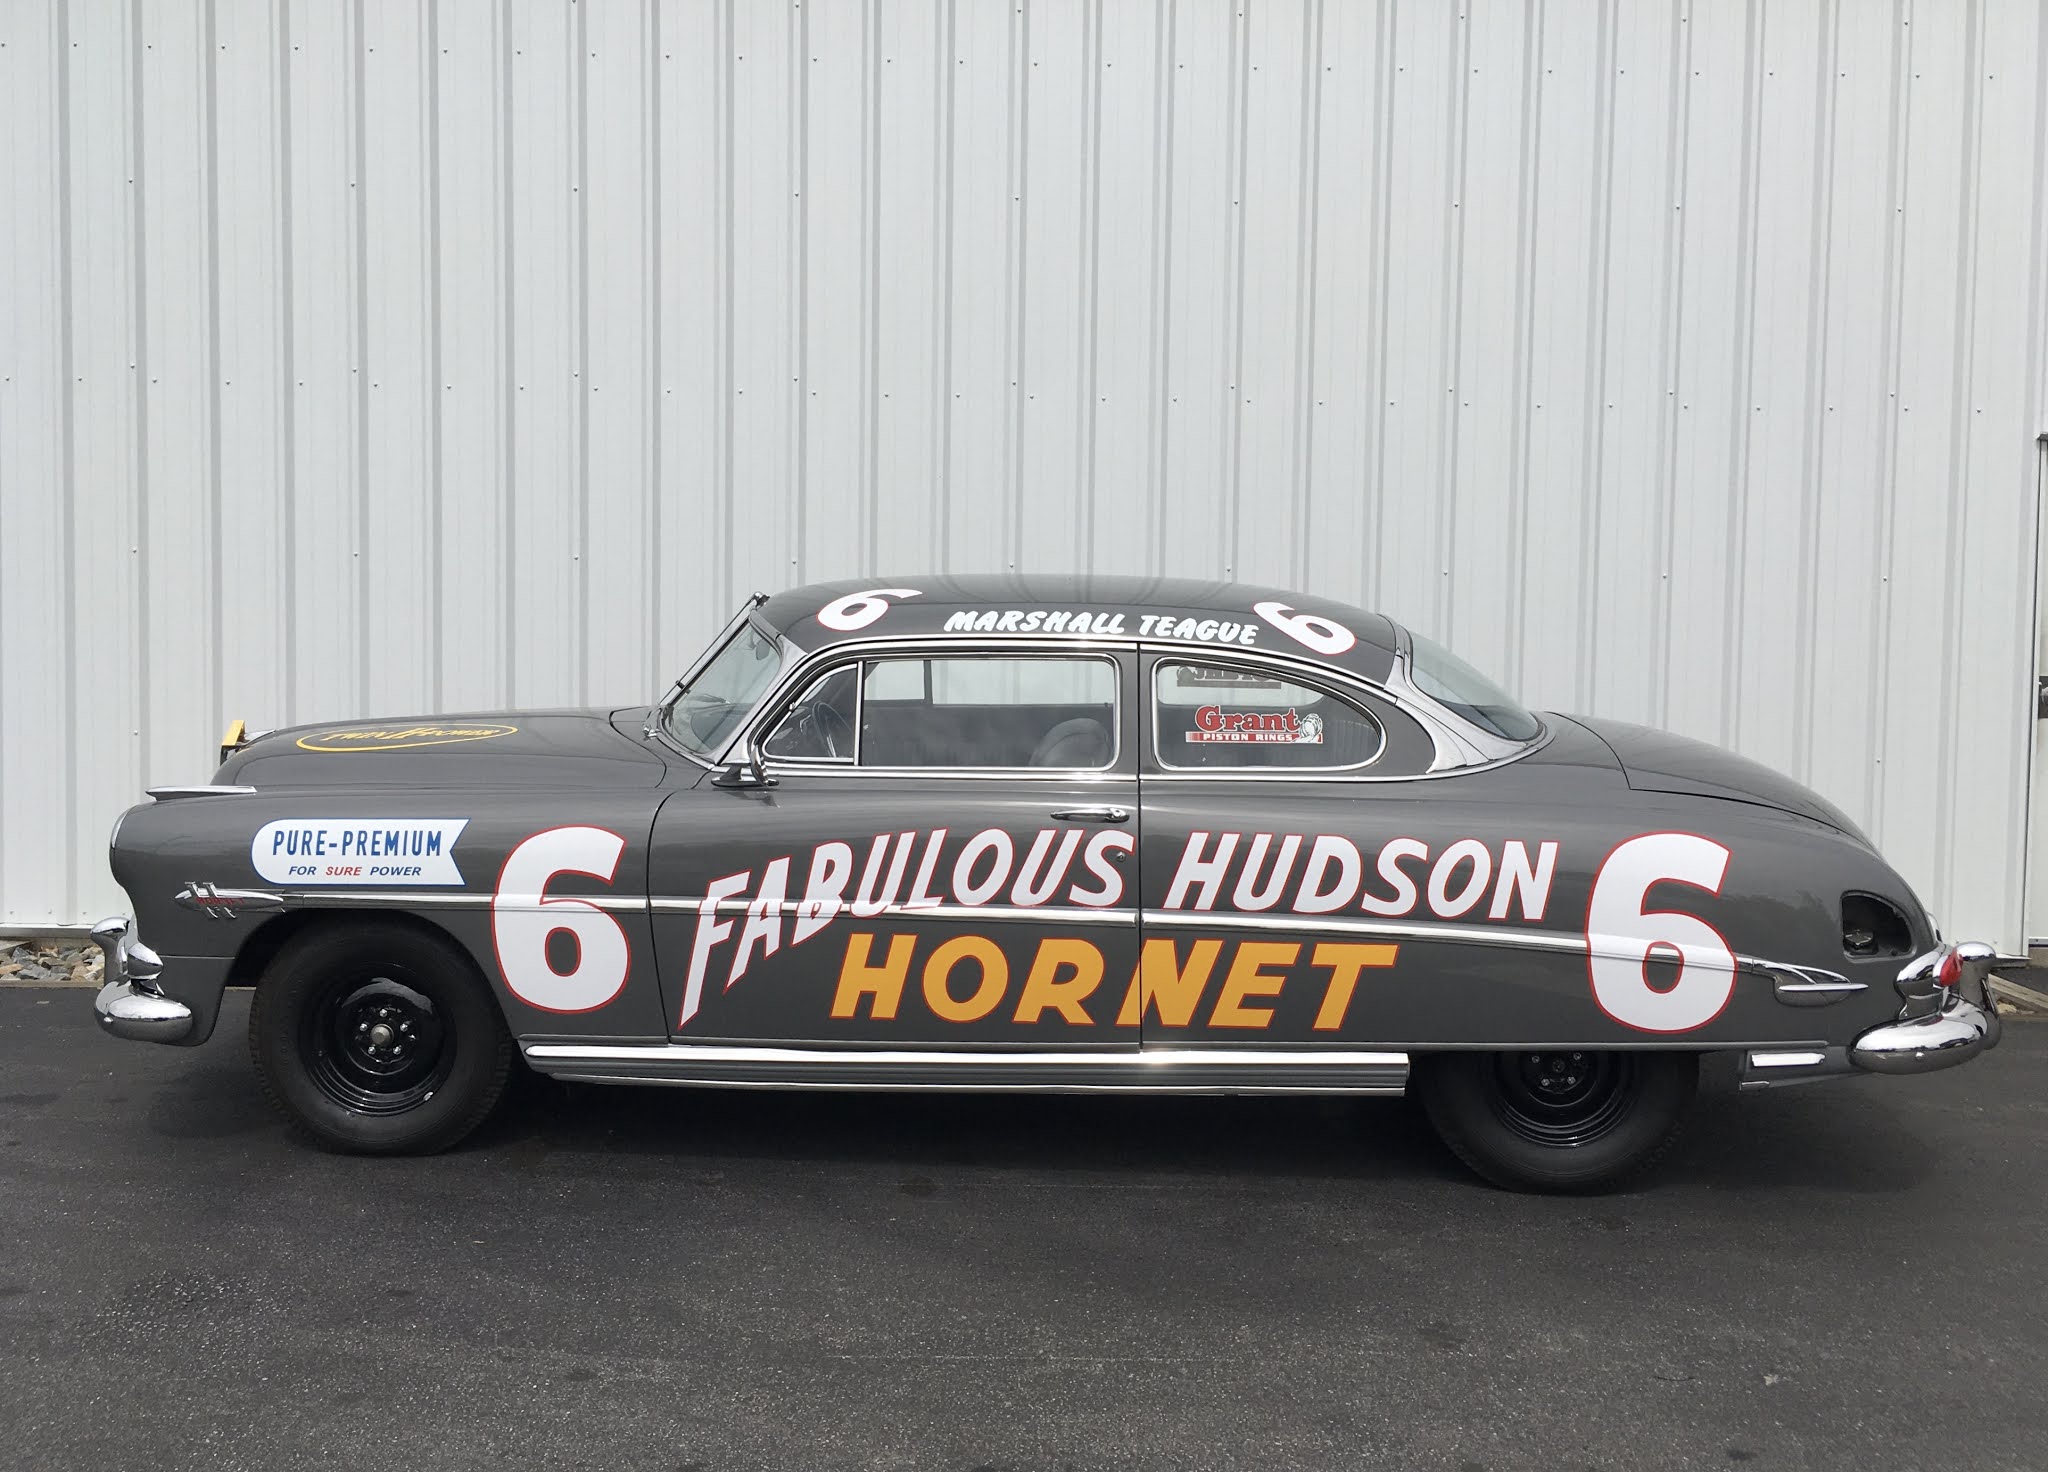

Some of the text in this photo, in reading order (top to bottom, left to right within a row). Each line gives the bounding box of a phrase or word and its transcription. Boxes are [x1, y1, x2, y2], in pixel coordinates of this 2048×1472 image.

[817, 588, 923, 632] 6
[943, 610, 1260, 645] MARSHALL TEAGUE
[1252, 601, 1357, 655] 6
[1195, 705, 1302, 732] Grant
[1203, 733, 1293, 741] PISTON RINGS
[272, 830, 442, 856] PURE-PREMIUM
[288, 866, 421, 876] FOR SURE POWER
[491, 824, 631, 1014] 6
[679, 828, 1560, 1030] FABULOUS HUDSON
[1586, 831, 1738, 1034] 6
[828, 933, 1399, 1032] HORNET
